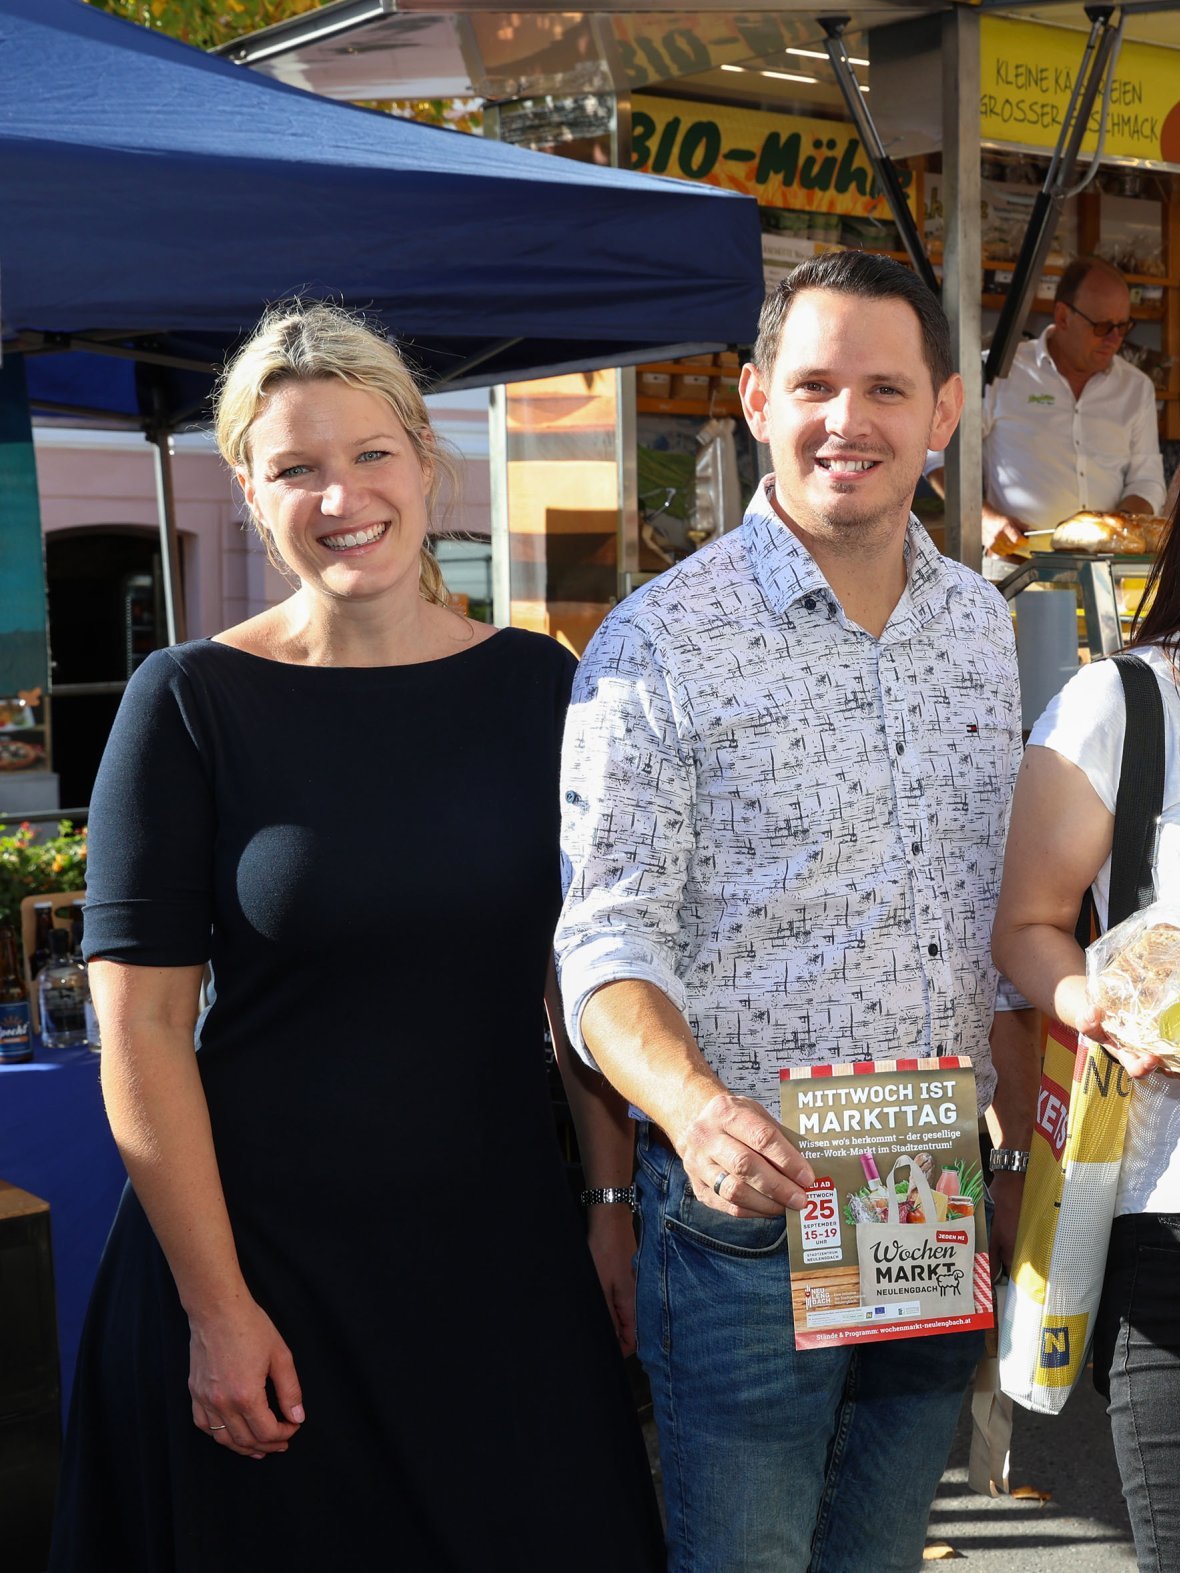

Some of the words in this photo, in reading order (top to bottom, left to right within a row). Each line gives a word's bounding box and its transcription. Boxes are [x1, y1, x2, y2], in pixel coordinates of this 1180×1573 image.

[996, 57, 1049, 94] KLEINE
[980, 94, 1062, 129] GROSSER
[798, 1084, 913, 1109] MITTWOCH
[920, 1081, 956, 1099] IST
[799, 1103, 957, 1135] MARKTTAG
[799, 1140, 830, 1149] Wissen
[852, 1134, 897, 1146] herkommt
[907, 1131, 921, 1141] der
[923, 1129, 961, 1142] gesellige
[878, 1146, 889, 1154] im
[891, 1141, 953, 1154] Stadtzentrum!
[804, 1199, 835, 1221] 25
[803, 1221, 837, 1229] SEPTEMBER
[804, 1228, 837, 1241] 15-19
[870, 1239, 957, 1264] Wochen
[875, 1262, 955, 1284] MARKT
[876, 1285, 938, 1296] NEULENGBACH
[816, 1332, 838, 1341] Stände
[845, 1329, 879, 1338] Programm:
[880, 1317, 971, 1334] wochenmarkt-neulengbach.at
